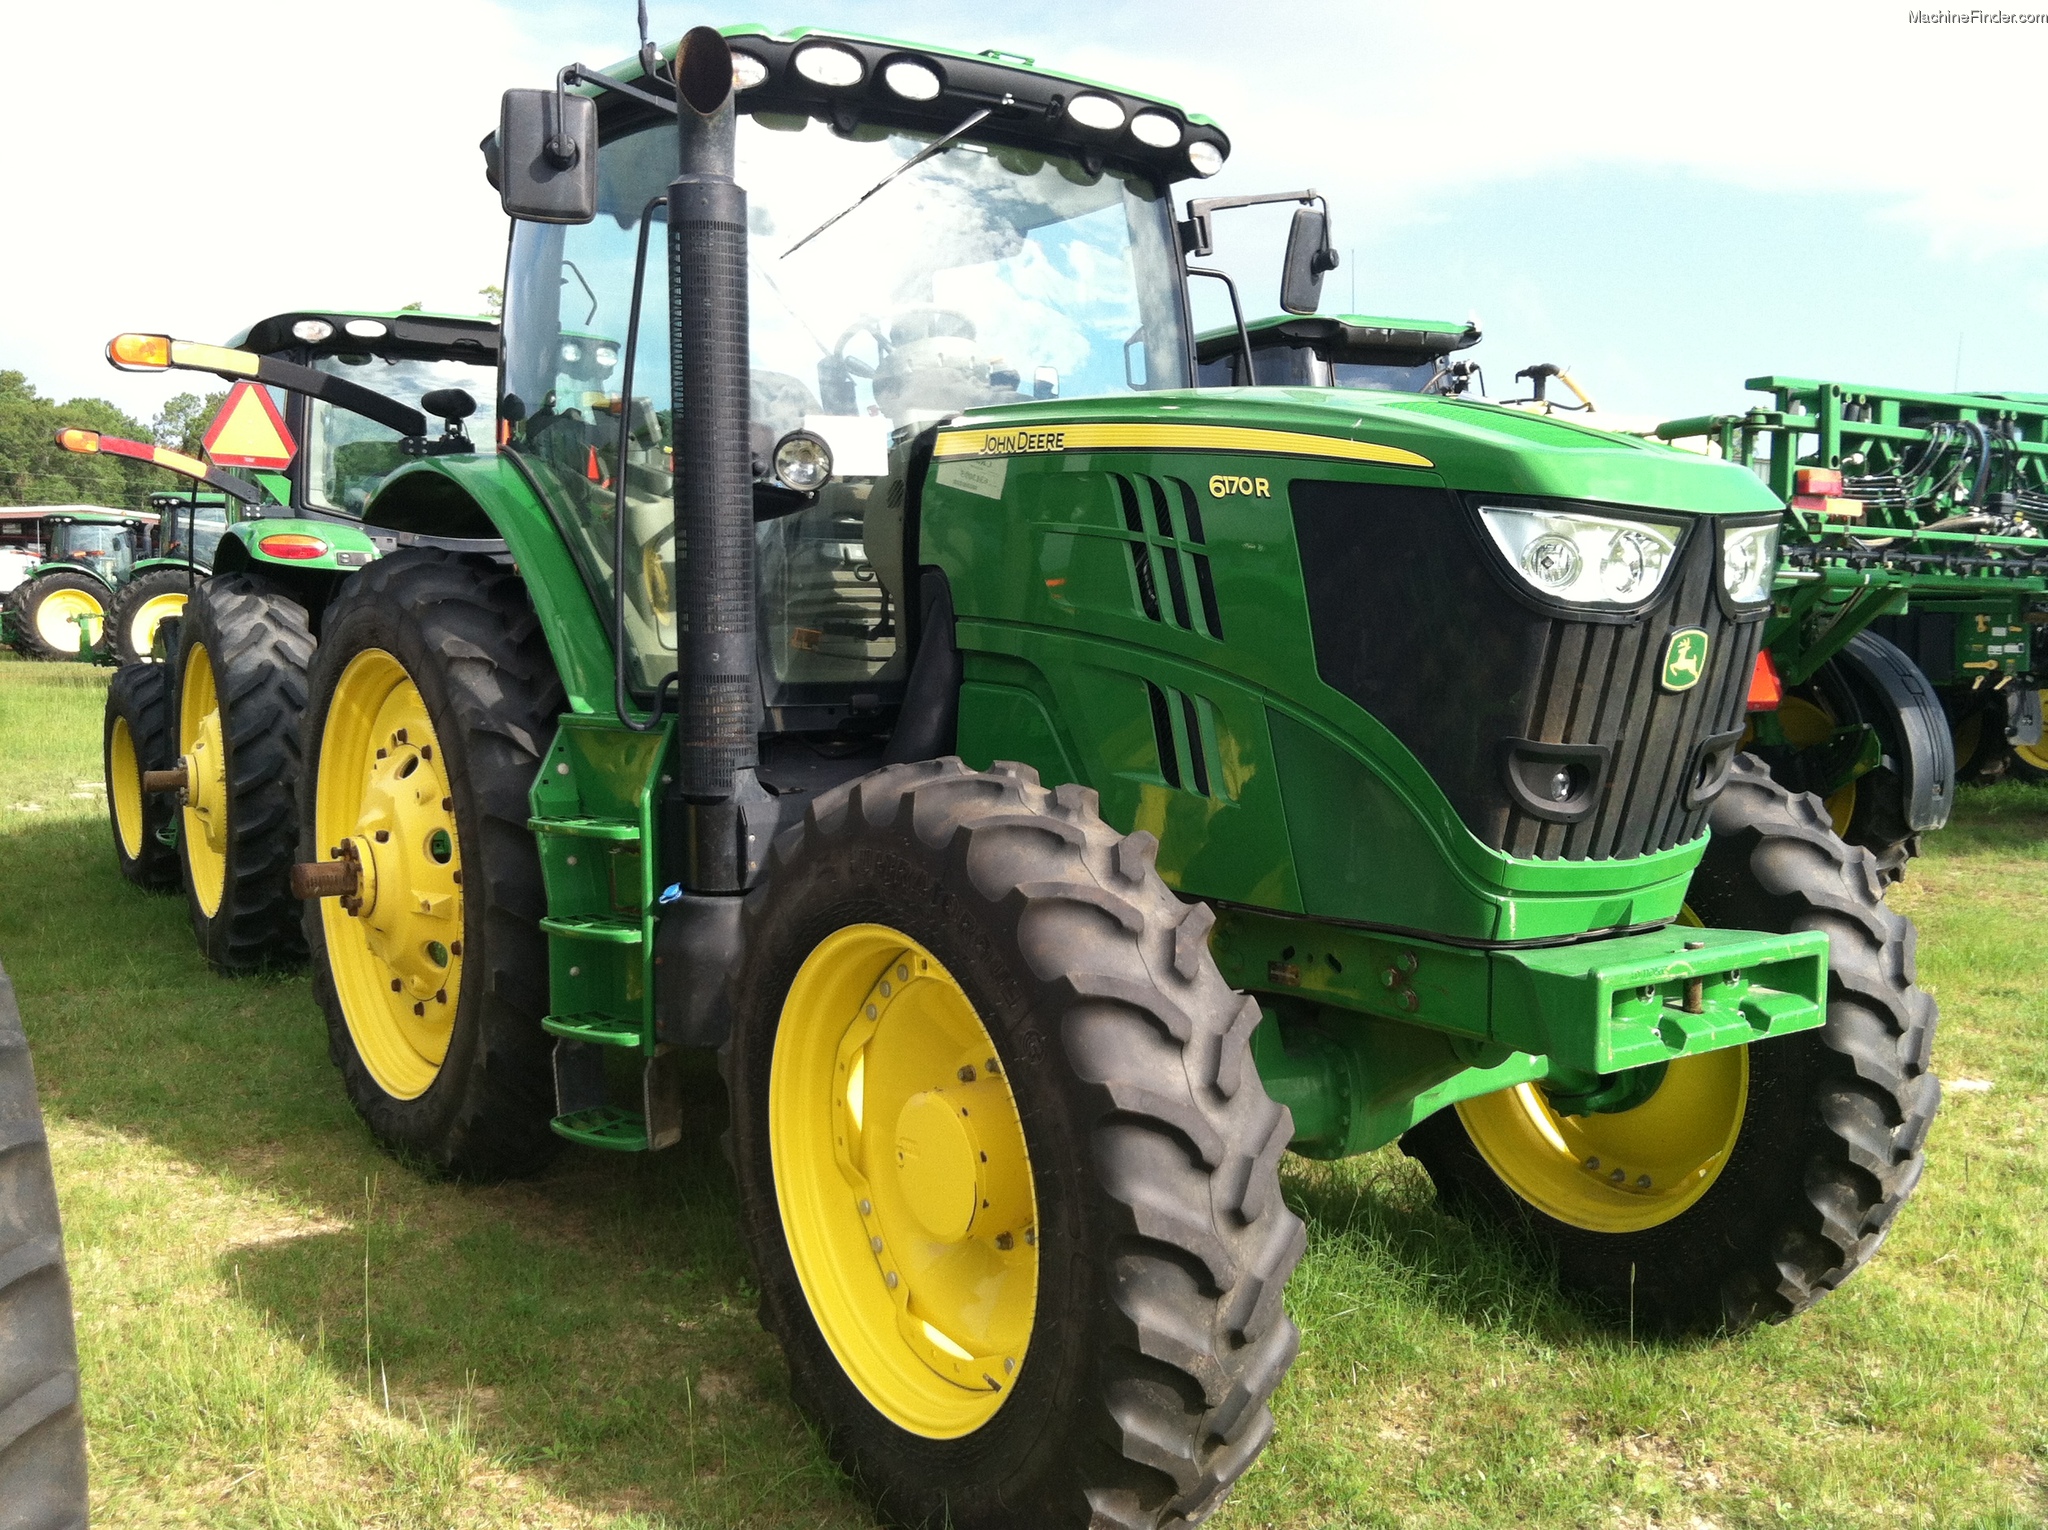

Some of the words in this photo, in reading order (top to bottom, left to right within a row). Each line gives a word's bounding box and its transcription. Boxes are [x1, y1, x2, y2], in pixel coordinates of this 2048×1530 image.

[979, 434, 1016, 453] JOHN
[1017, 431, 1065, 451] DEERE
[1208, 474, 1271, 499] 6170R
